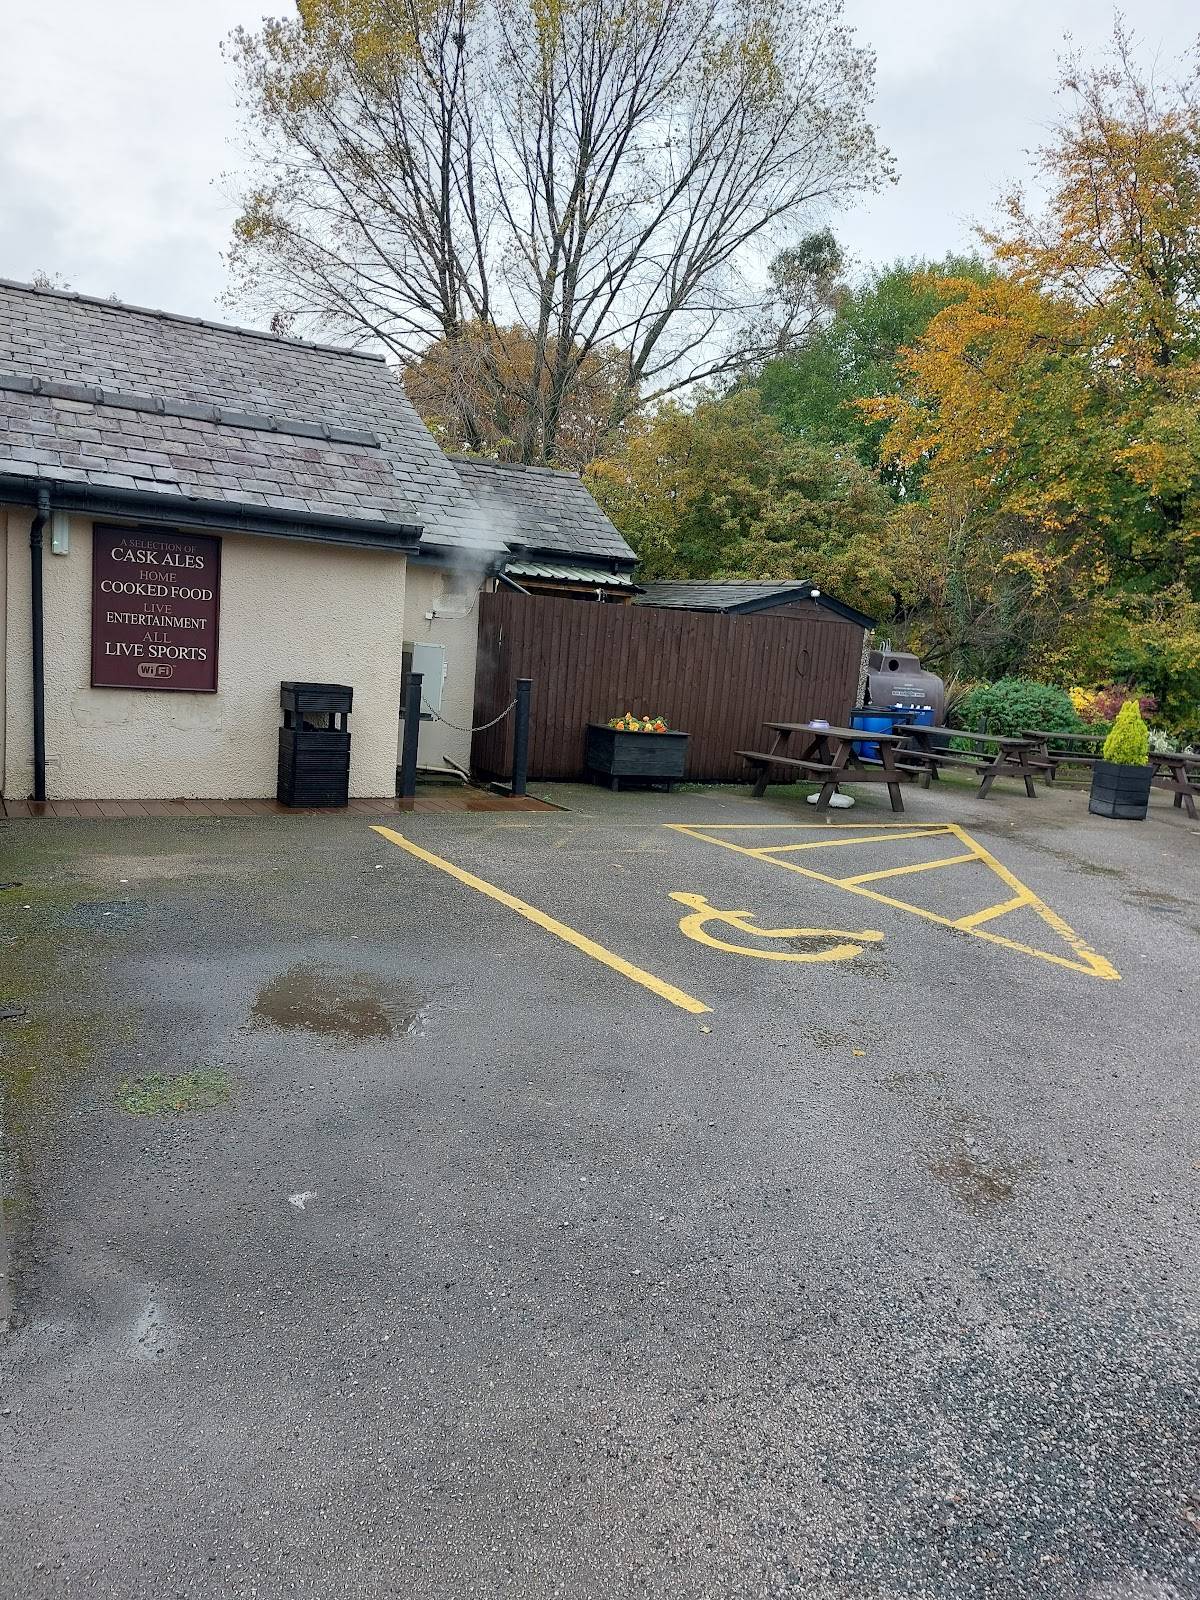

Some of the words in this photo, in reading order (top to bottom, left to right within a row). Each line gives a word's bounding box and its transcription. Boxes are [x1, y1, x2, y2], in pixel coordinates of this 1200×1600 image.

[129, 540, 184, 552] SELECTION
[185, 545, 197, 553] OF
[111, 547, 159, 565] CASK
[162, 553, 204, 569] ALES
[140, 570, 177, 583] HOME
[101, 580, 168, 597] COOKED
[171, 586, 213, 601] FOOD
[144, 603, 173, 614] LIVE
[106, 611, 207, 630] ENTERTAINMENT
[142, 631, 172, 644] ALL
[105, 642, 144, 657] LIVE
[148, 645, 207, 661] SPORTS
